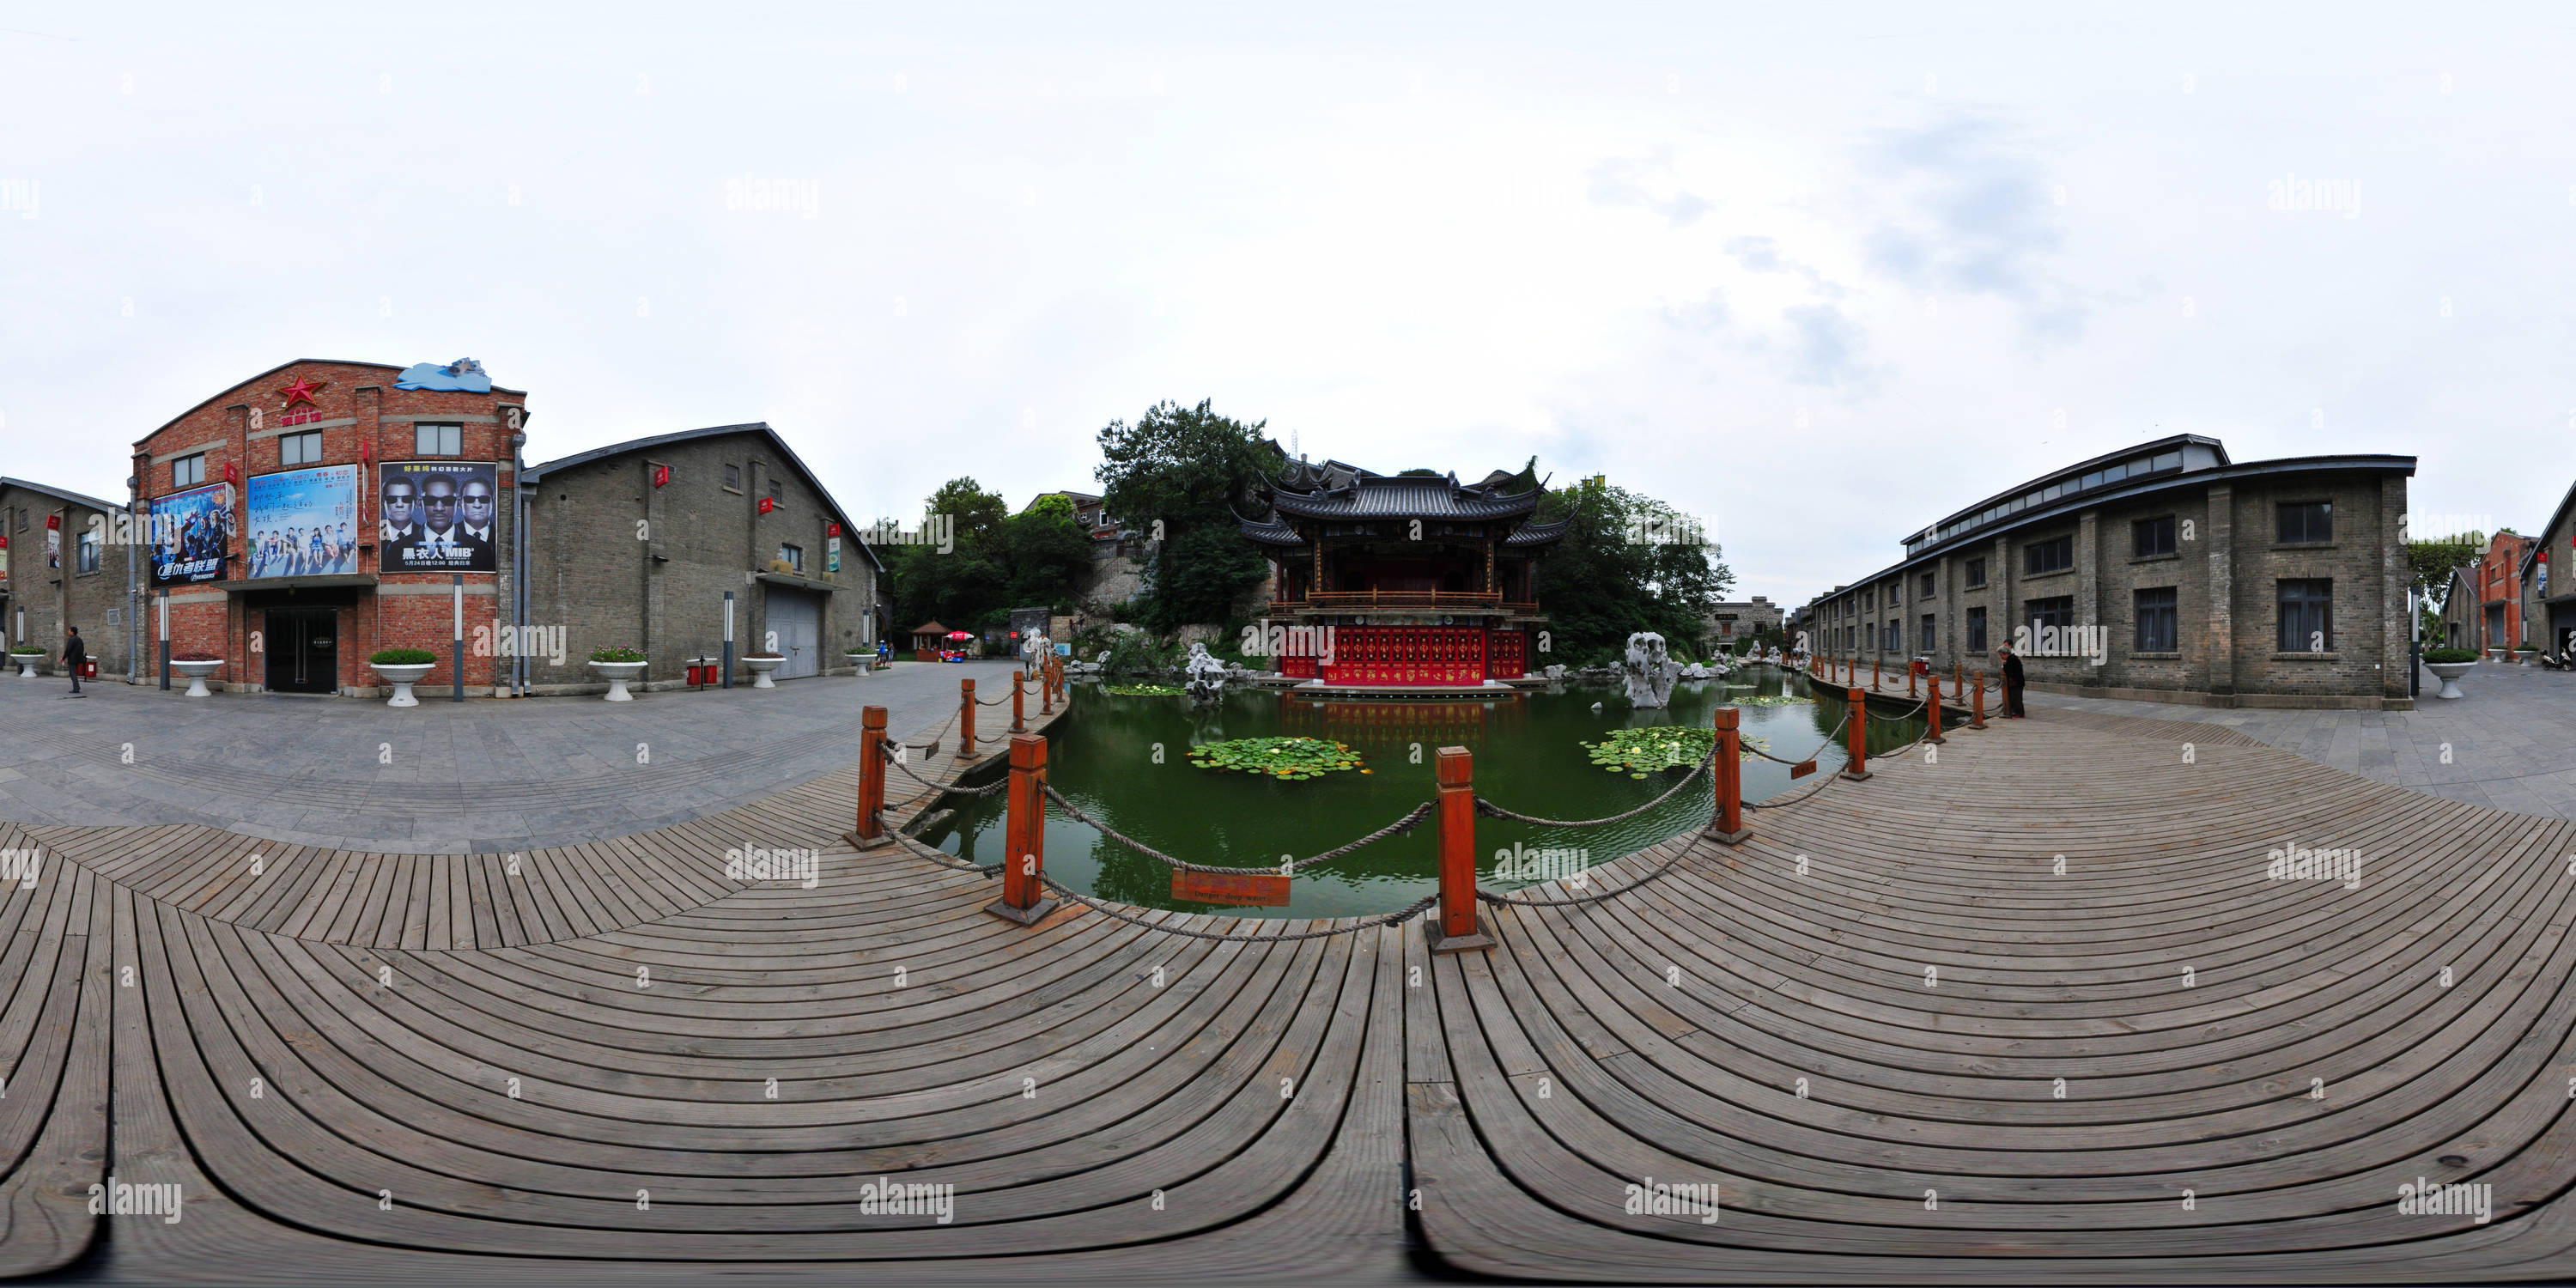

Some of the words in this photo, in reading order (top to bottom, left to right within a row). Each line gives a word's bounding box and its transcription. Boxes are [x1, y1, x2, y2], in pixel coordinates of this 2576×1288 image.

[158, 558, 220, 579] 复仇者联盟
